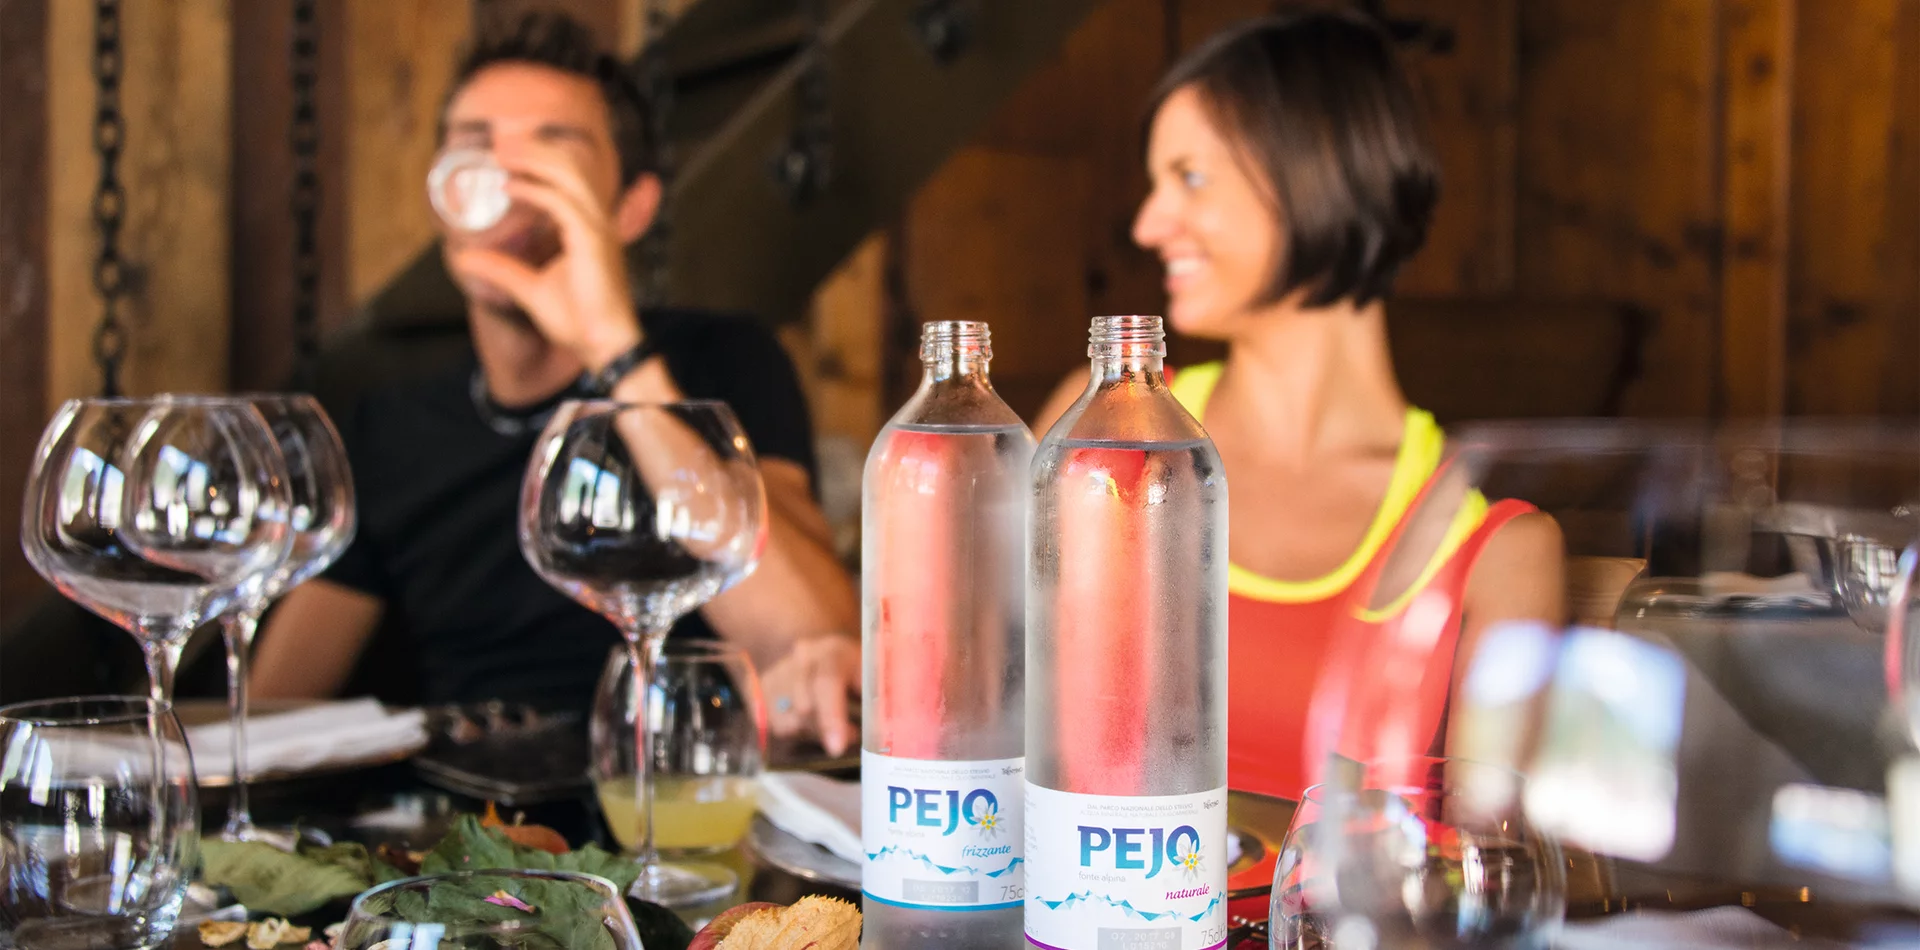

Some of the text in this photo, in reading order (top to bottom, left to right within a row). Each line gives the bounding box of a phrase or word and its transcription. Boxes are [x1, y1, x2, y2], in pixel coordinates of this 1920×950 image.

[887, 785, 999, 837] PEJO
[962, 844, 1012, 858] frizzante
[1077, 824, 1201, 880] PEJO
[1078, 871, 1126, 884] fonte alpina
[1000, 884, 1024, 901] 75c
[1165, 882, 1210, 900] naturale
